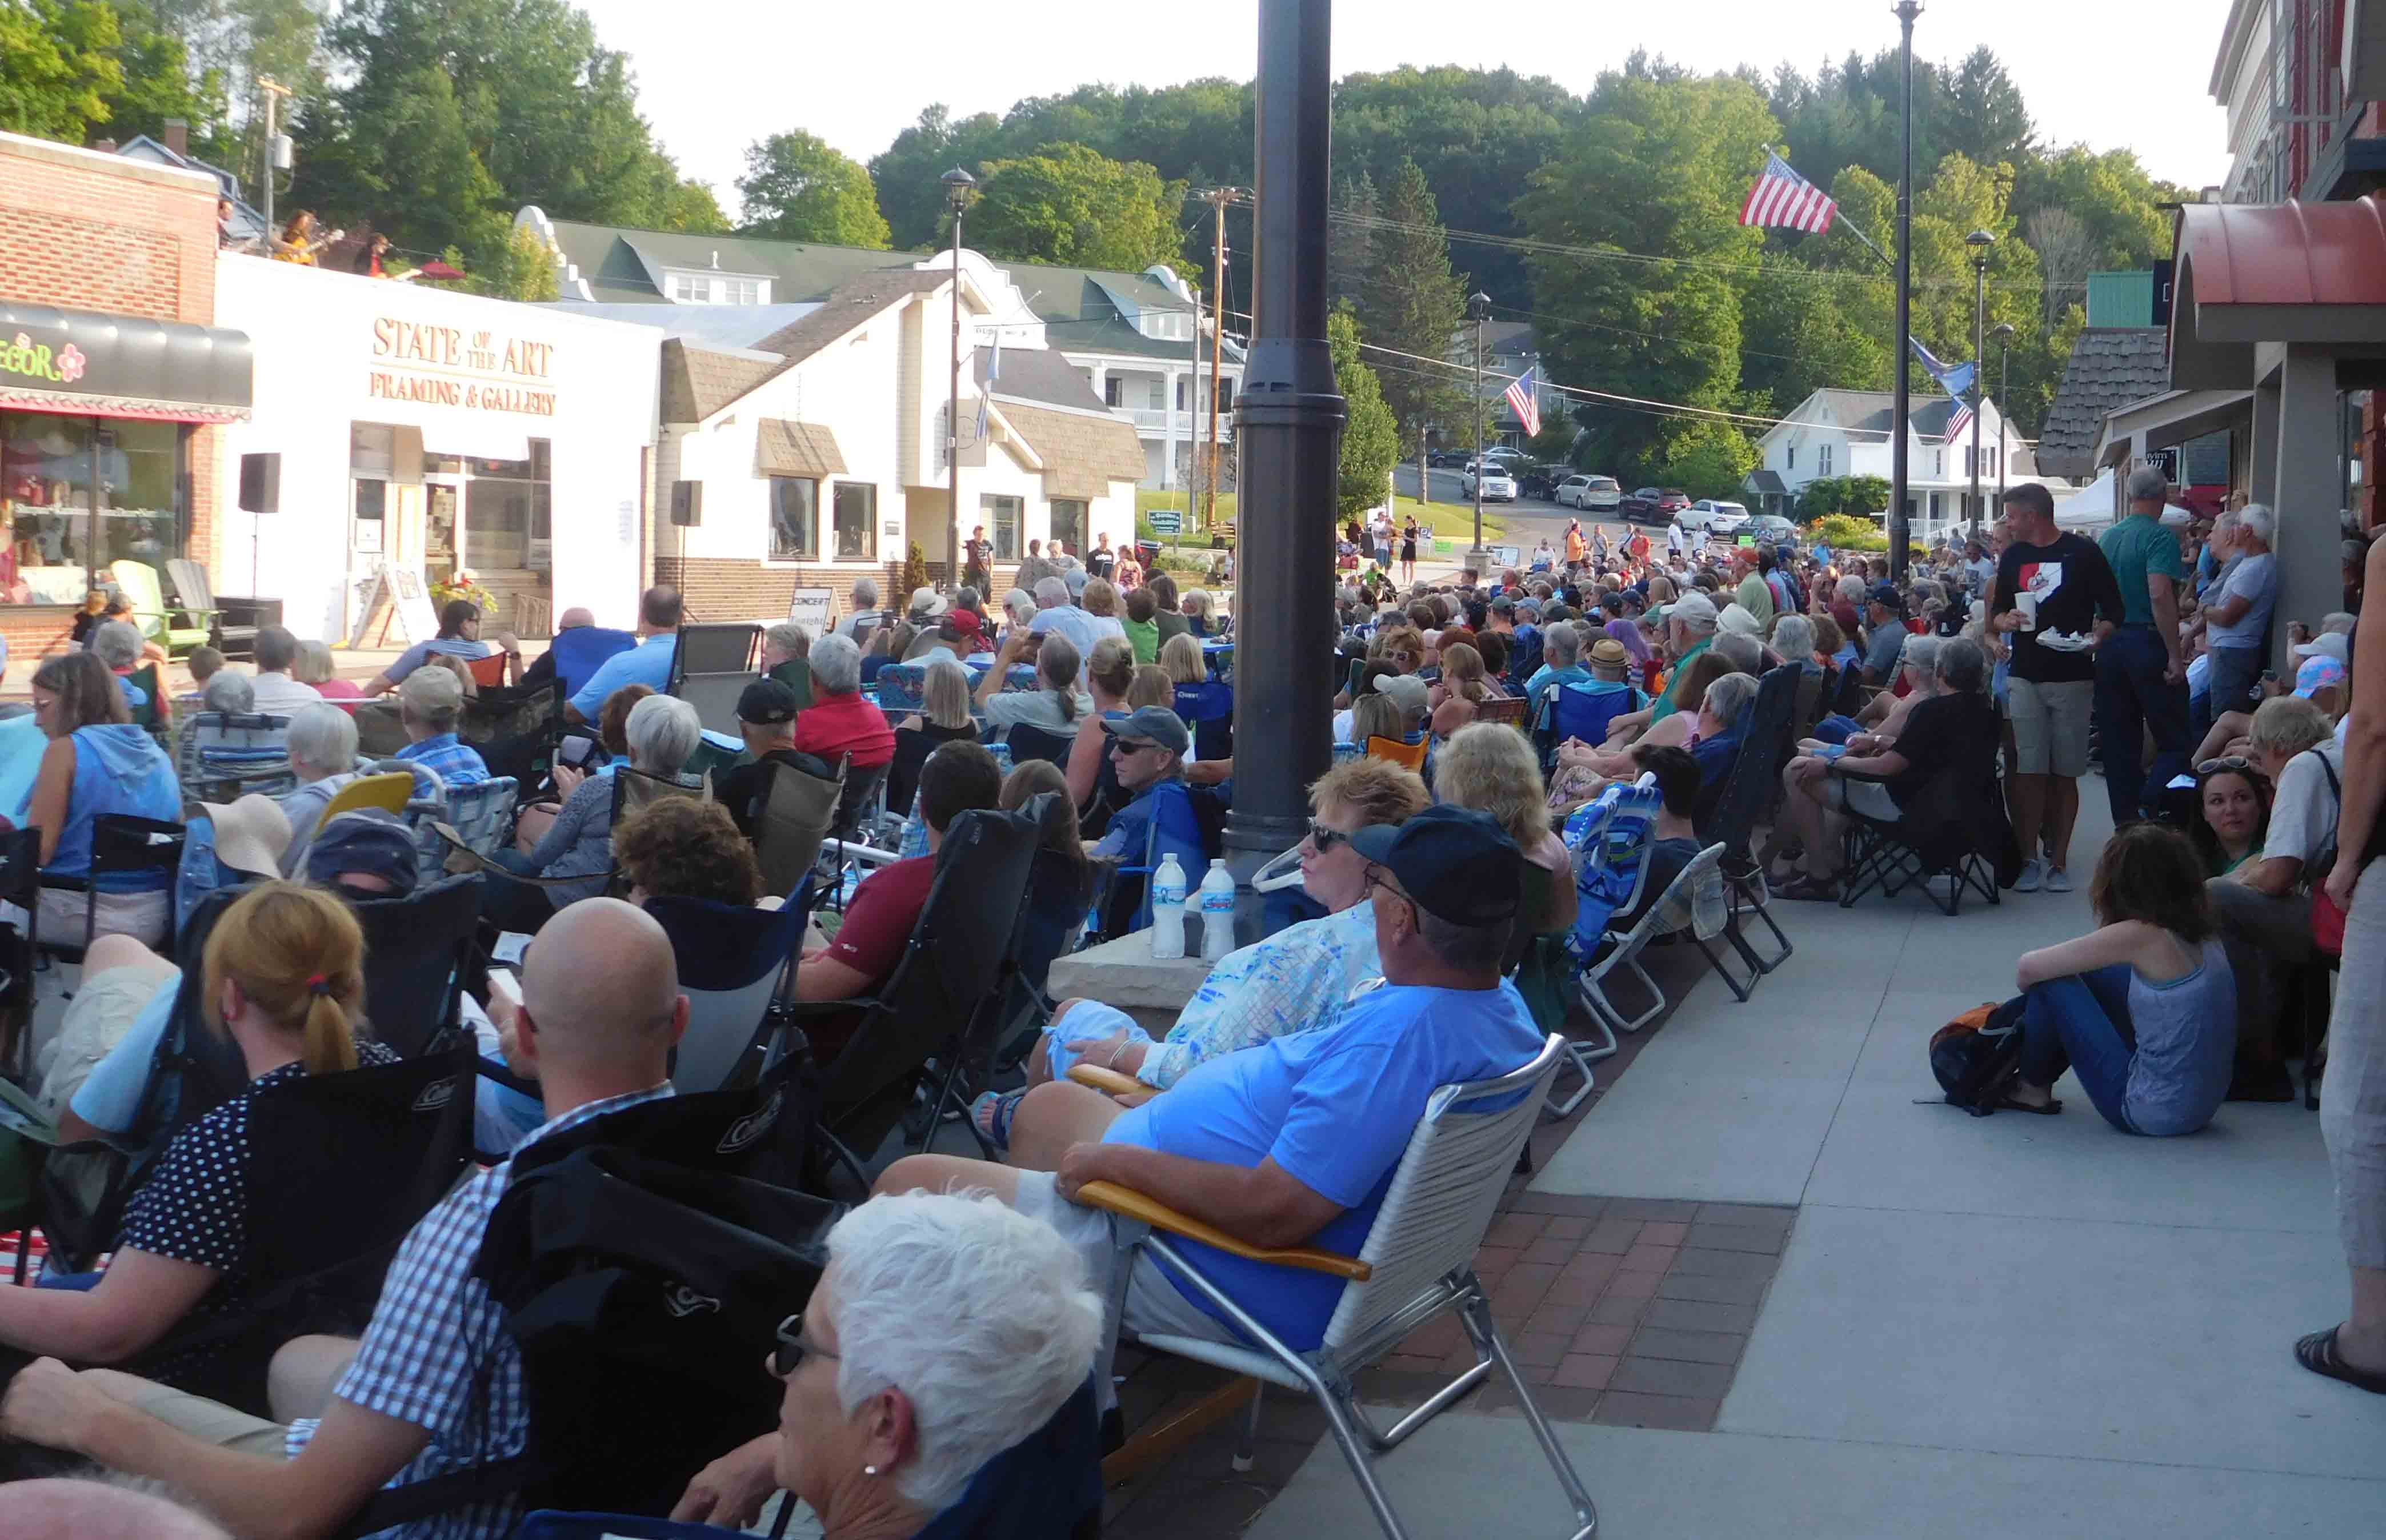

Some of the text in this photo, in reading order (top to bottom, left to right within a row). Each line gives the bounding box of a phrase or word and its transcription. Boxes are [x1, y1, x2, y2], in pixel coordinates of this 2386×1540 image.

[373, 318, 461, 366] STATE
[502, 337, 554, 378] ART
[467, 349, 496, 370] THE
[370, 371, 556, 416] FRAMING & GALLERY
